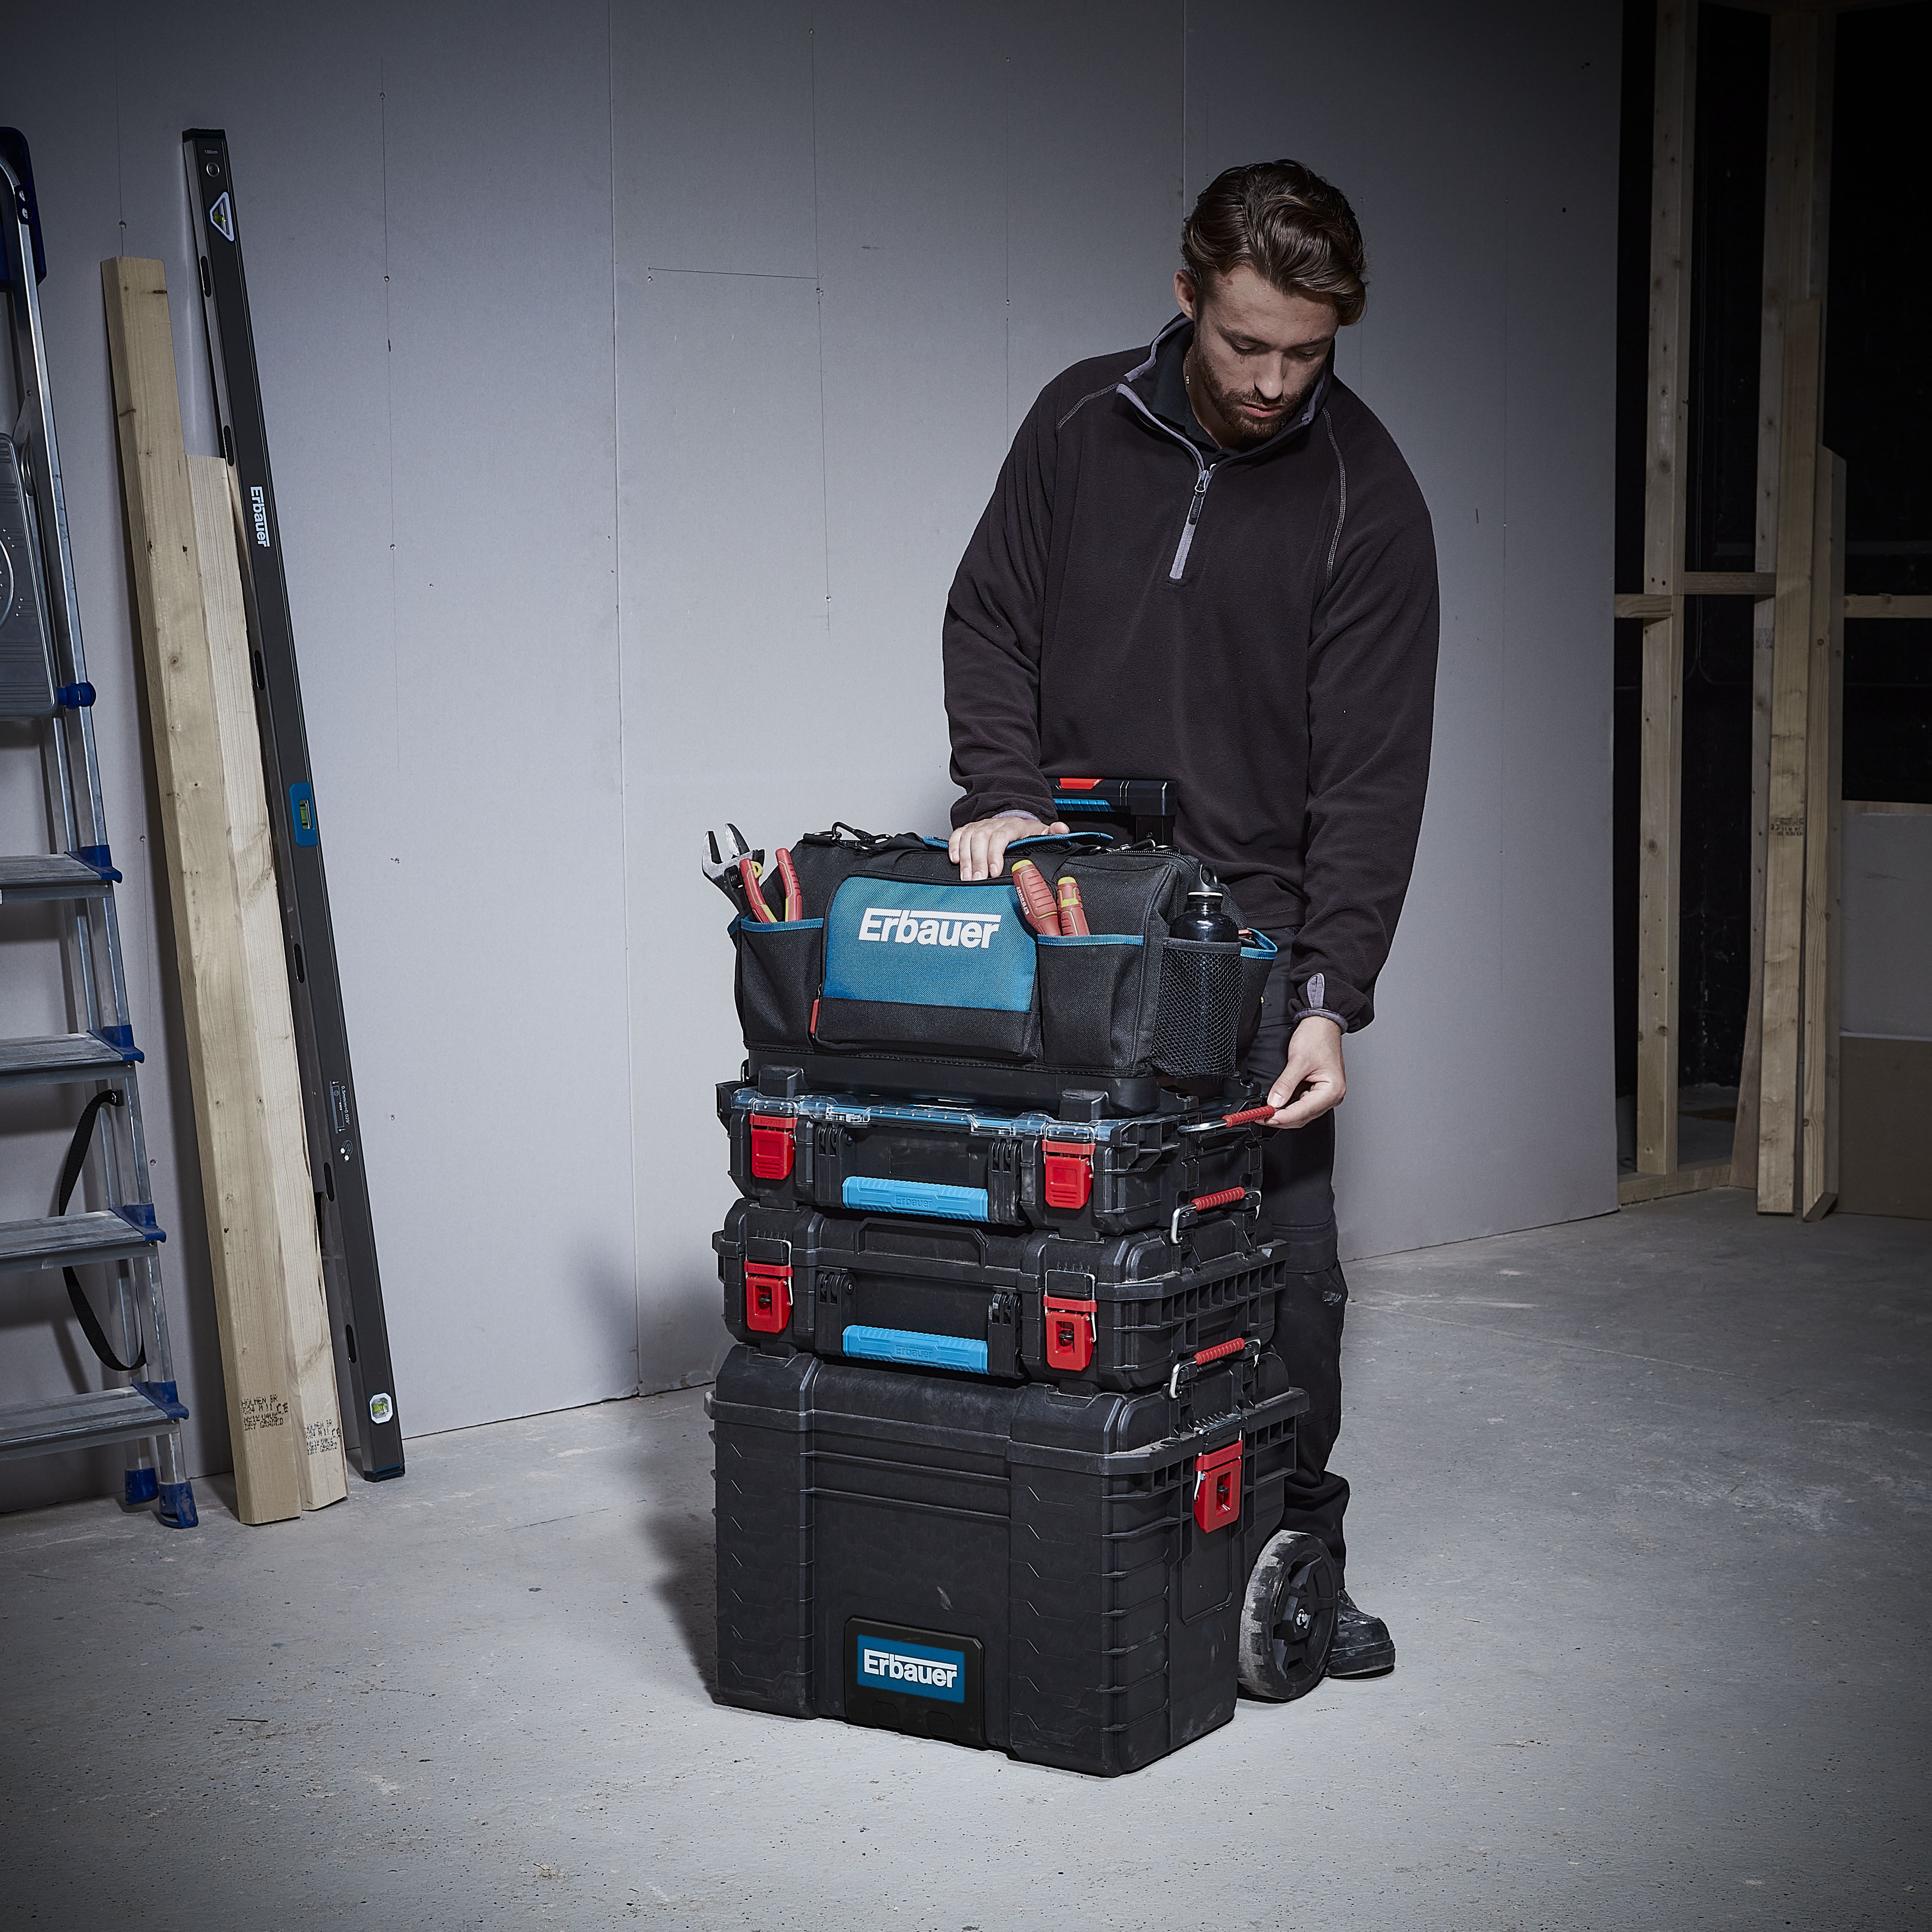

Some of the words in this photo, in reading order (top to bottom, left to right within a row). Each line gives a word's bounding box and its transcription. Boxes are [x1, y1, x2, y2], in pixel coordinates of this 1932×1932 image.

[250, 486, 270, 547] Erbauer
[1016, 886, 1030, 915] Erbauer
[858, 907, 1002, 949] Erbauer
[1054, 1144, 1077, 1152] Erbauer
[895, 1194, 932, 1208] Erbauer
[895, 1344, 933, 1359] Erbauer
[240, 1396, 267, 1406] HOLMEN
[864, 1648, 957, 1688] Erbauer
